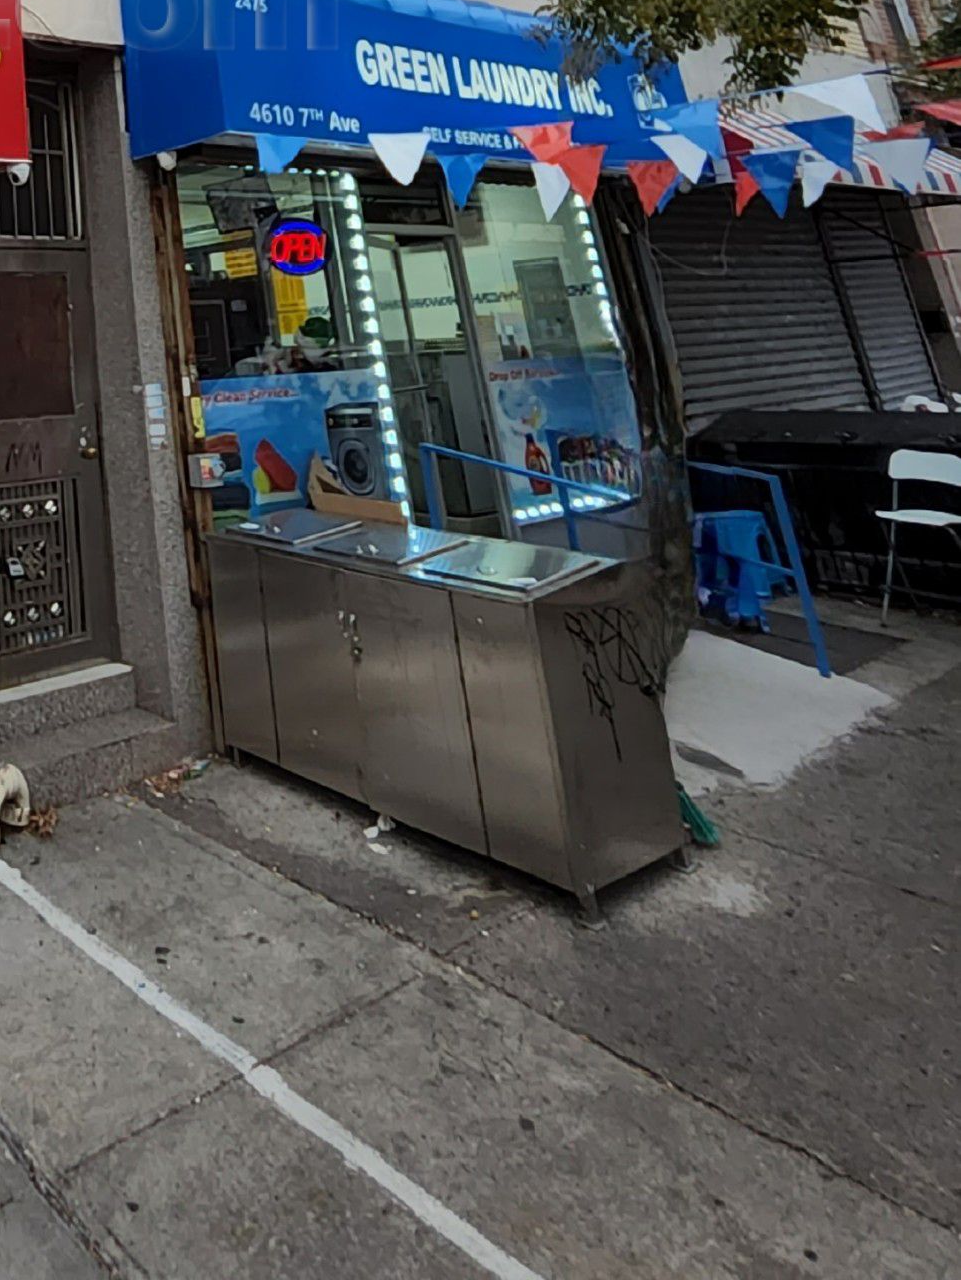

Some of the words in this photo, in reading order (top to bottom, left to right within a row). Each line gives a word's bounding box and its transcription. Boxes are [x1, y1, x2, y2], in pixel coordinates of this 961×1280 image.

[356, 39, 450, 96] GREEN
[452, 56, 562, 110] LAUNDRY
[565, 74, 614, 117] INC.
[249, 102, 295, 127] 4610
[298, 107, 324, 128] 7TH
[329, 111, 361, 133] Ave
[454, 129, 503, 149] SERVICE
[270, 232, 327, 262] OPEN
[214, 391, 247, 403] Clean
